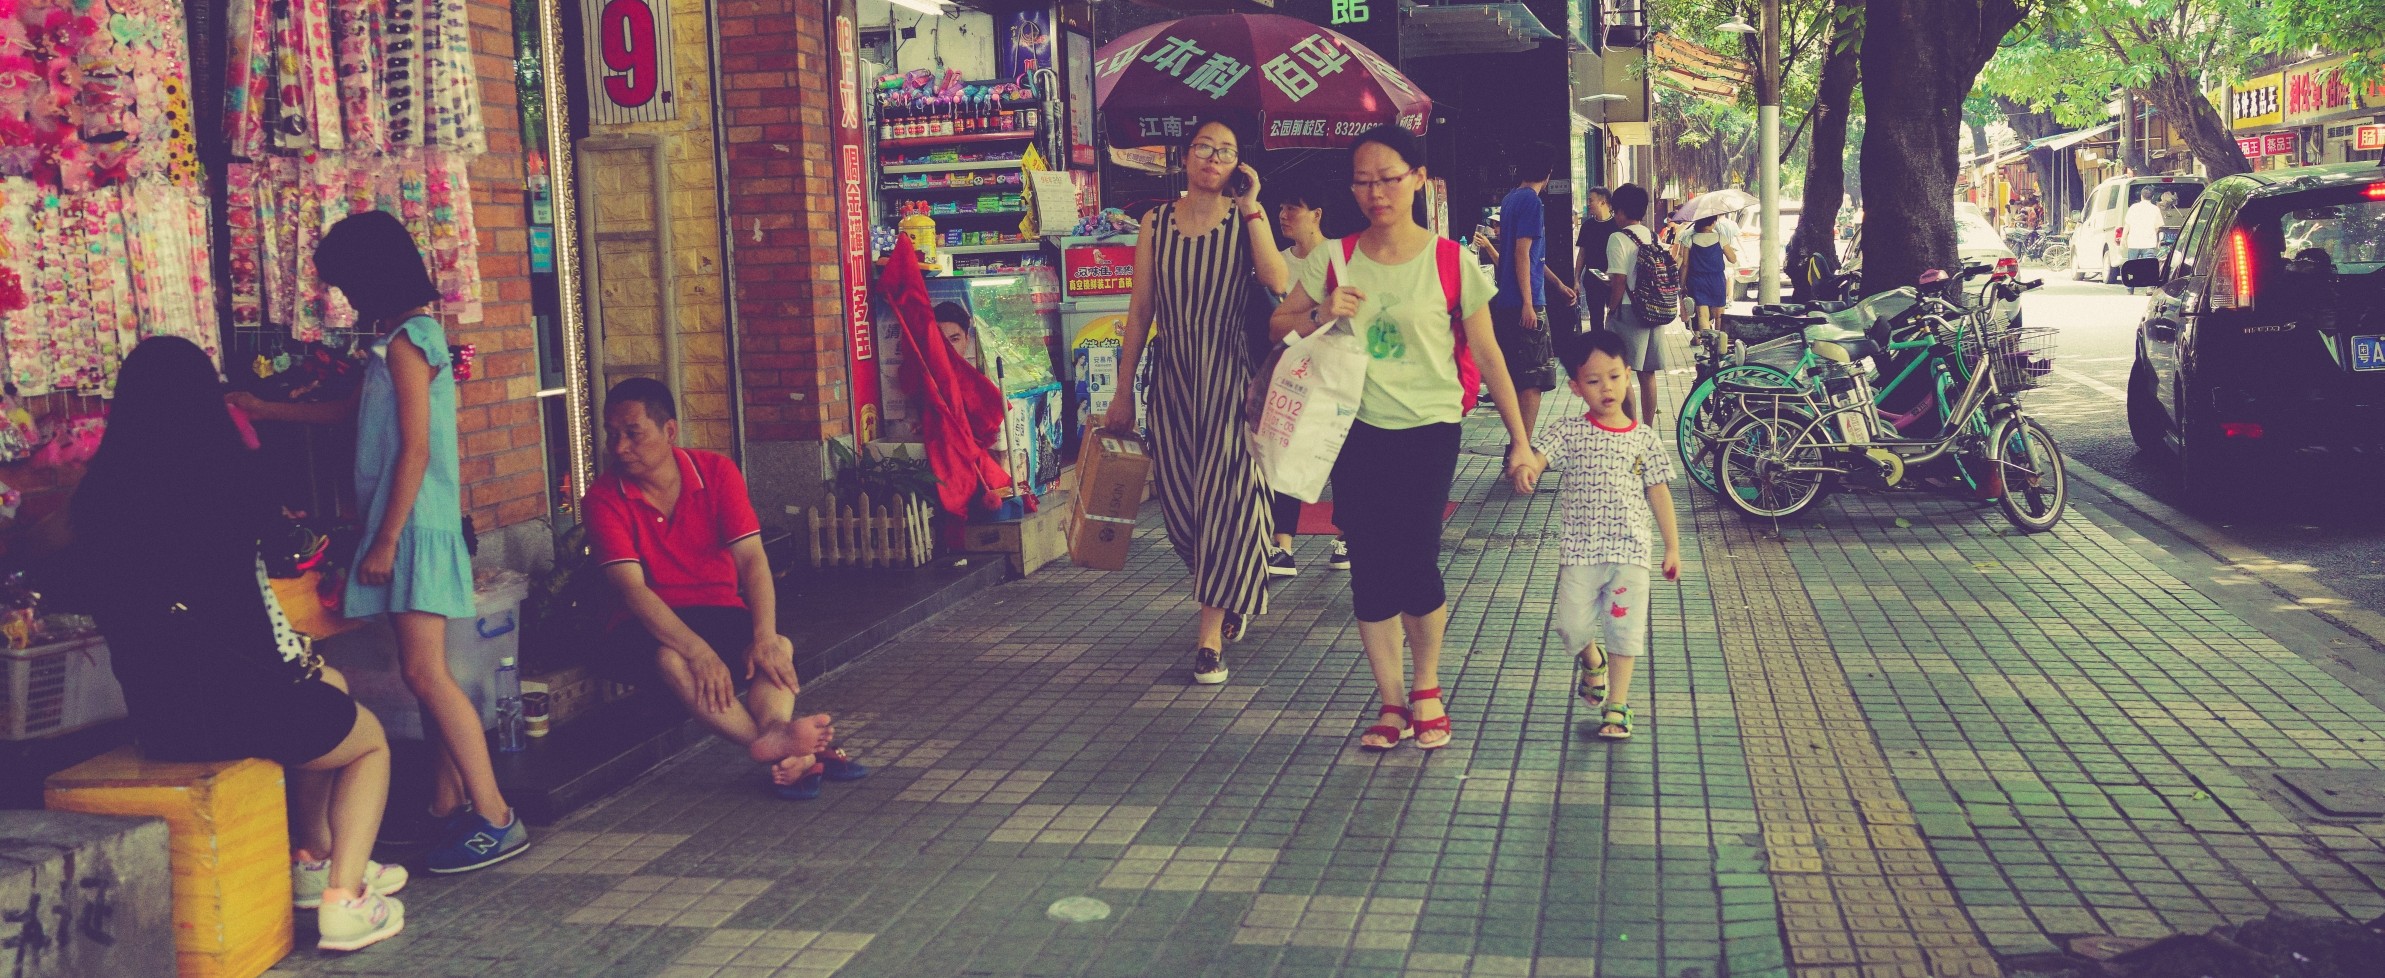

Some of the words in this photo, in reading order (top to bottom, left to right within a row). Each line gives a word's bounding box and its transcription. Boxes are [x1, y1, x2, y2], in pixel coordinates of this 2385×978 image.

[836, 16, 857, 129] 怕上火
[1140, 35, 1251, 100] 本科
[843, 145, 872, 360] 喝金罐加多宝
[1269, 390, 1302, 416] 2012
